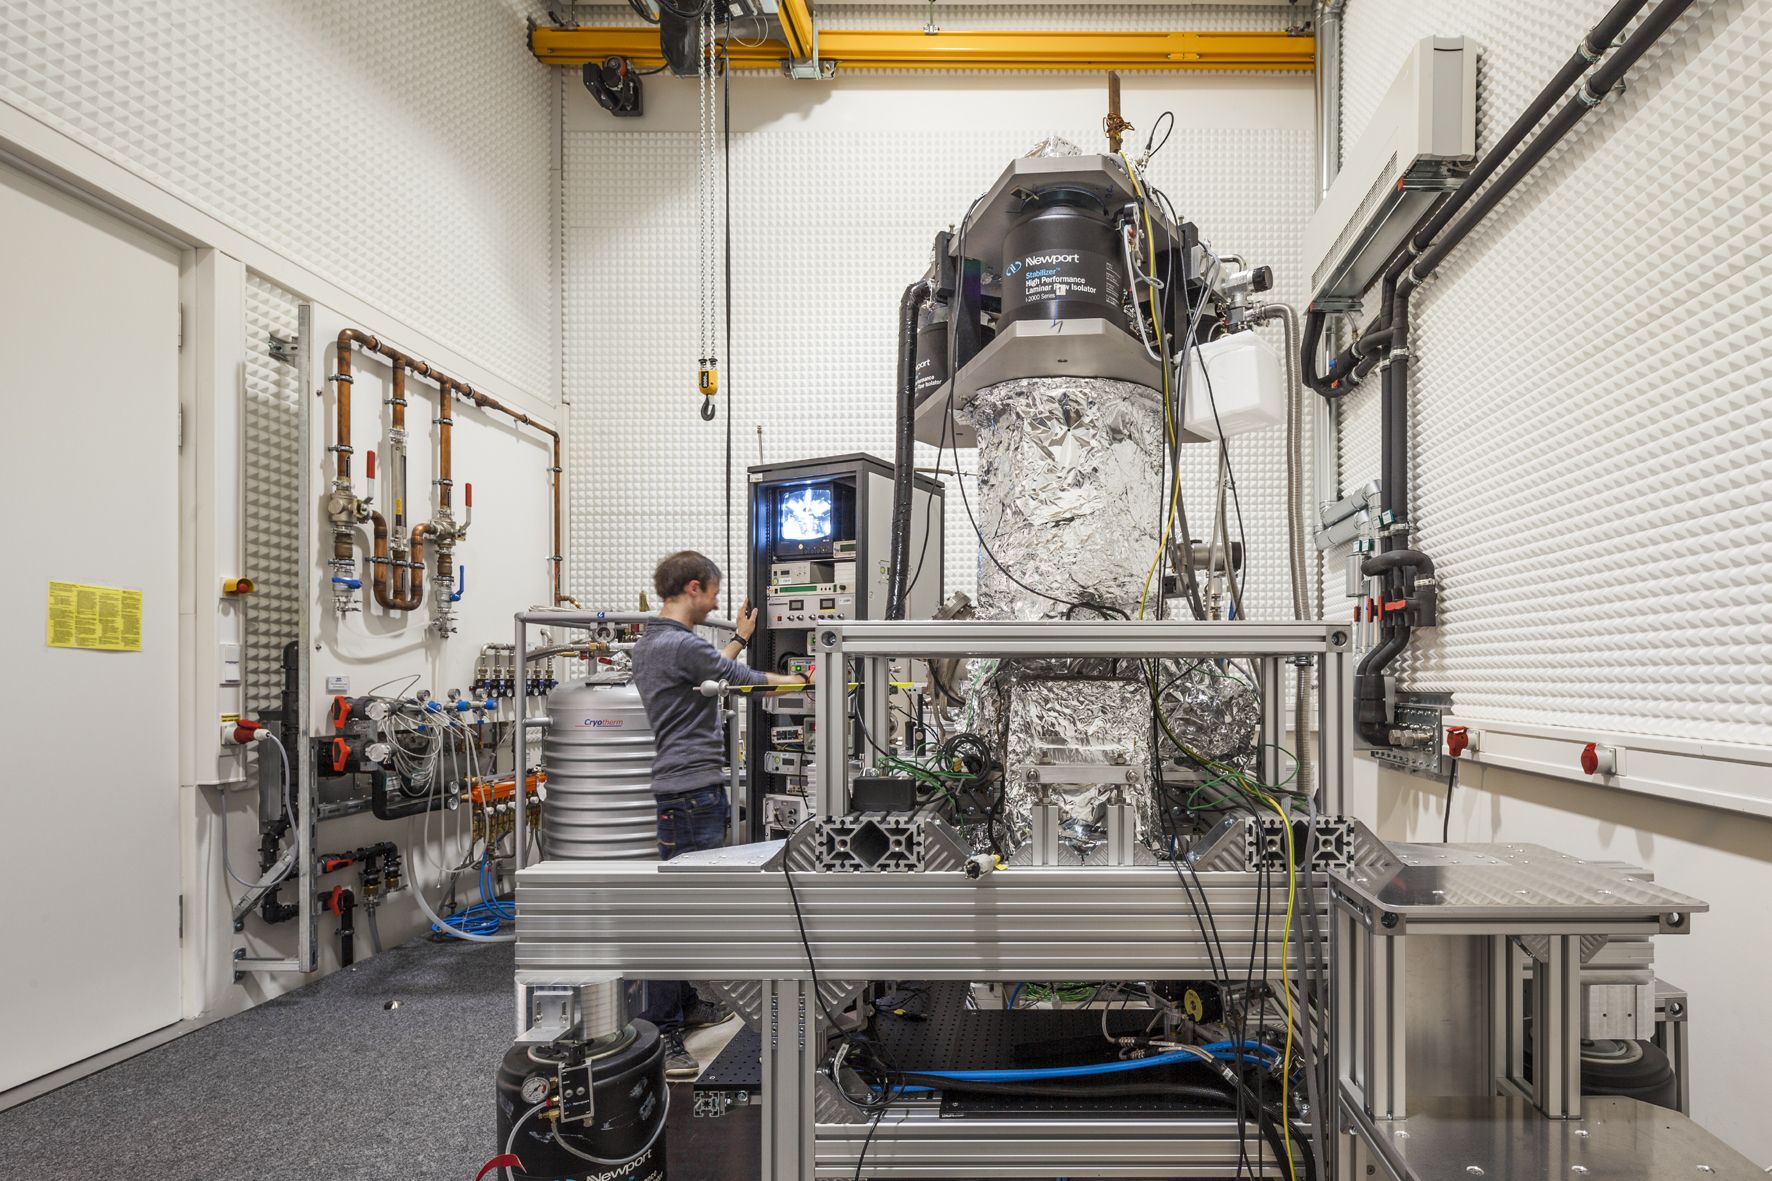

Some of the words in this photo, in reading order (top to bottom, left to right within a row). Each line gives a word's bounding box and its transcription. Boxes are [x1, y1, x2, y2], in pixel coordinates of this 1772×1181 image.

[1025, 253, 1080, 267] Newport
[1025, 277, 1040, 288] High
[1041, 275, 1086, 284] Performance
[1025, 284, 1052, 295] Laminar
[1071, 283, 1097, 294] Isolator
[915, 359, 931, 370] port
[584, 718, 624, 728] Cryotherm
